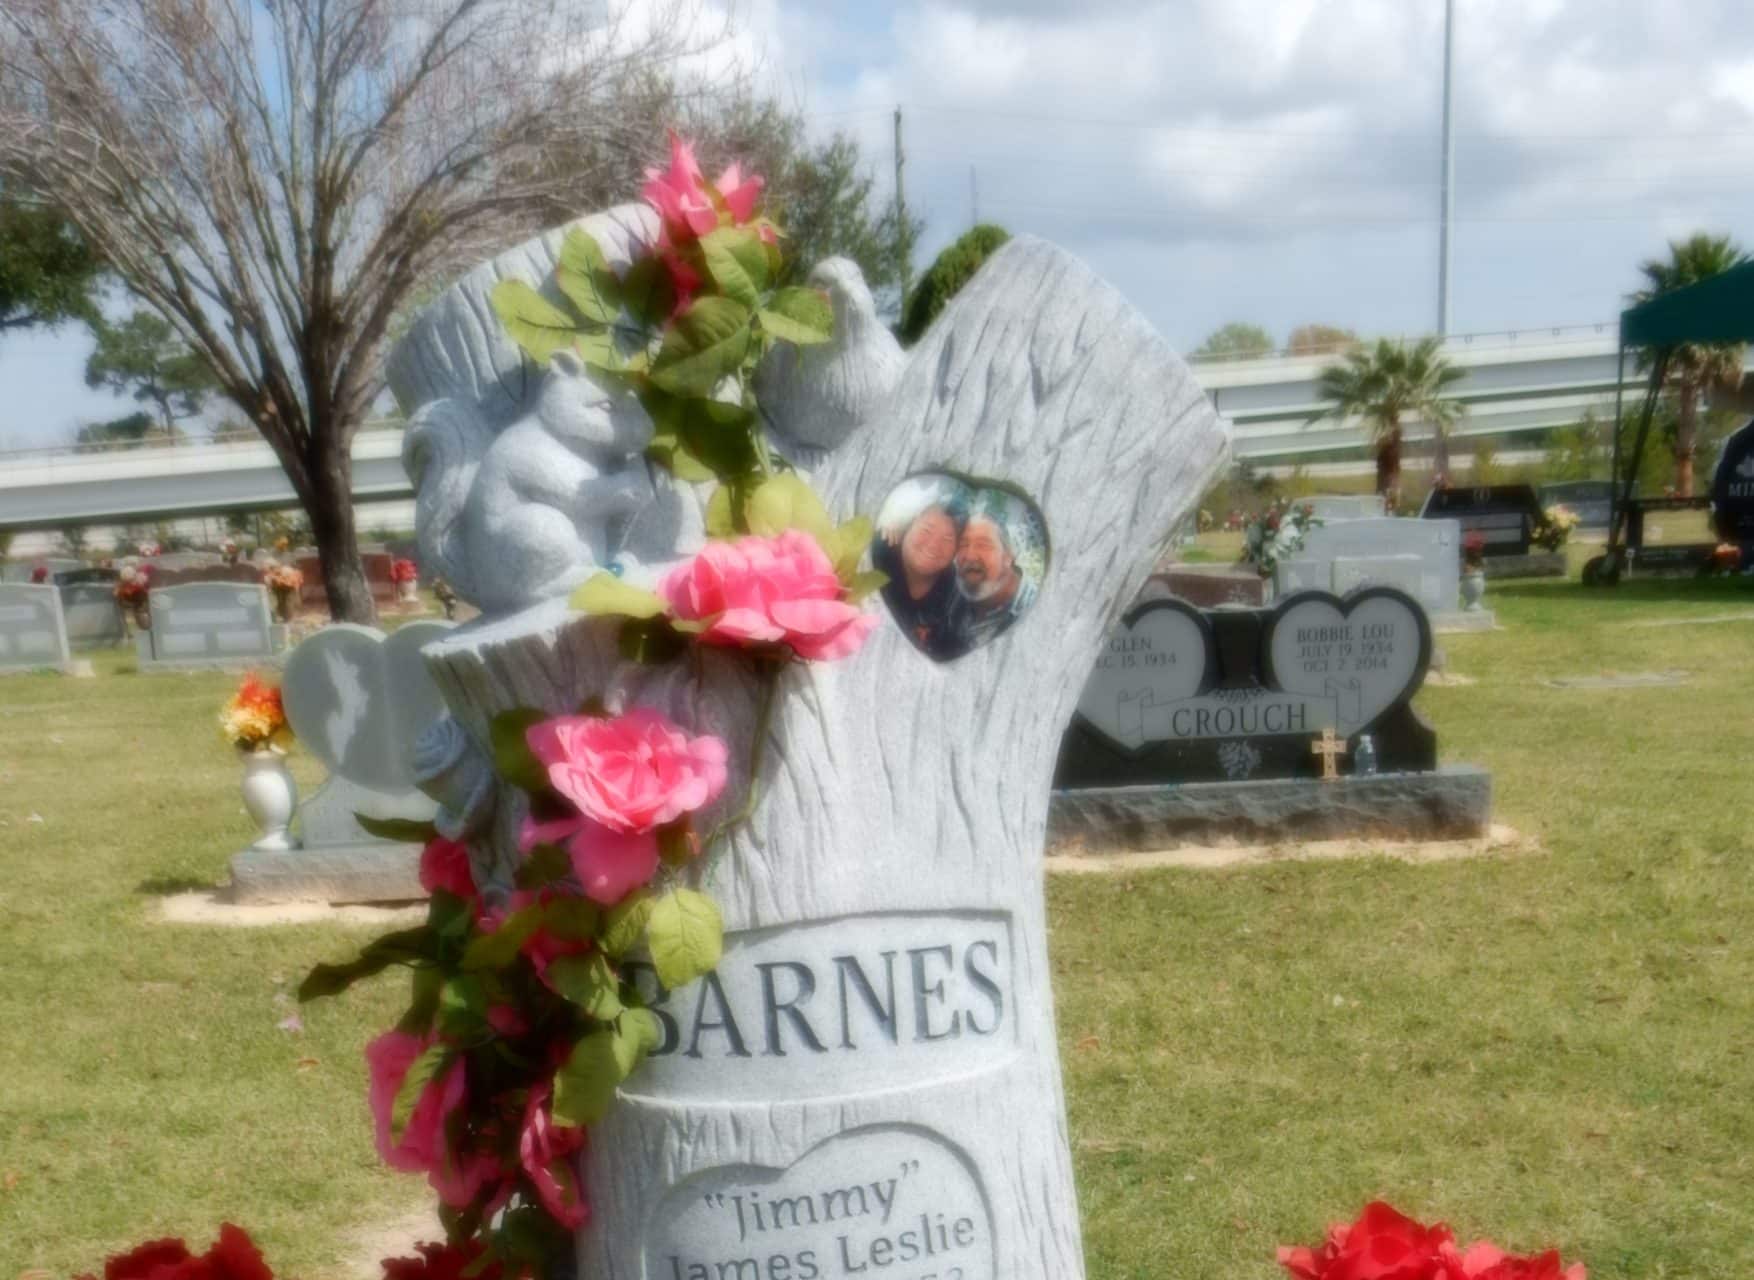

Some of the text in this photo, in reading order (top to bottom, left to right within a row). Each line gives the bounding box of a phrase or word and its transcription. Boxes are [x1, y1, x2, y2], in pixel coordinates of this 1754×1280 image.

[1110, 636, 1152, 653] GLEN
[1297, 623, 1395, 643] BOBBIE LOU
[1298, 643, 1331, 658] JULY
[1172, 703, 1306, 738] CROUCH
[619, 940, 1004, 1058] BARNES
[704, 1160, 919, 1241] "Jimmy"
[837, 1213, 975, 1274] Leslie
